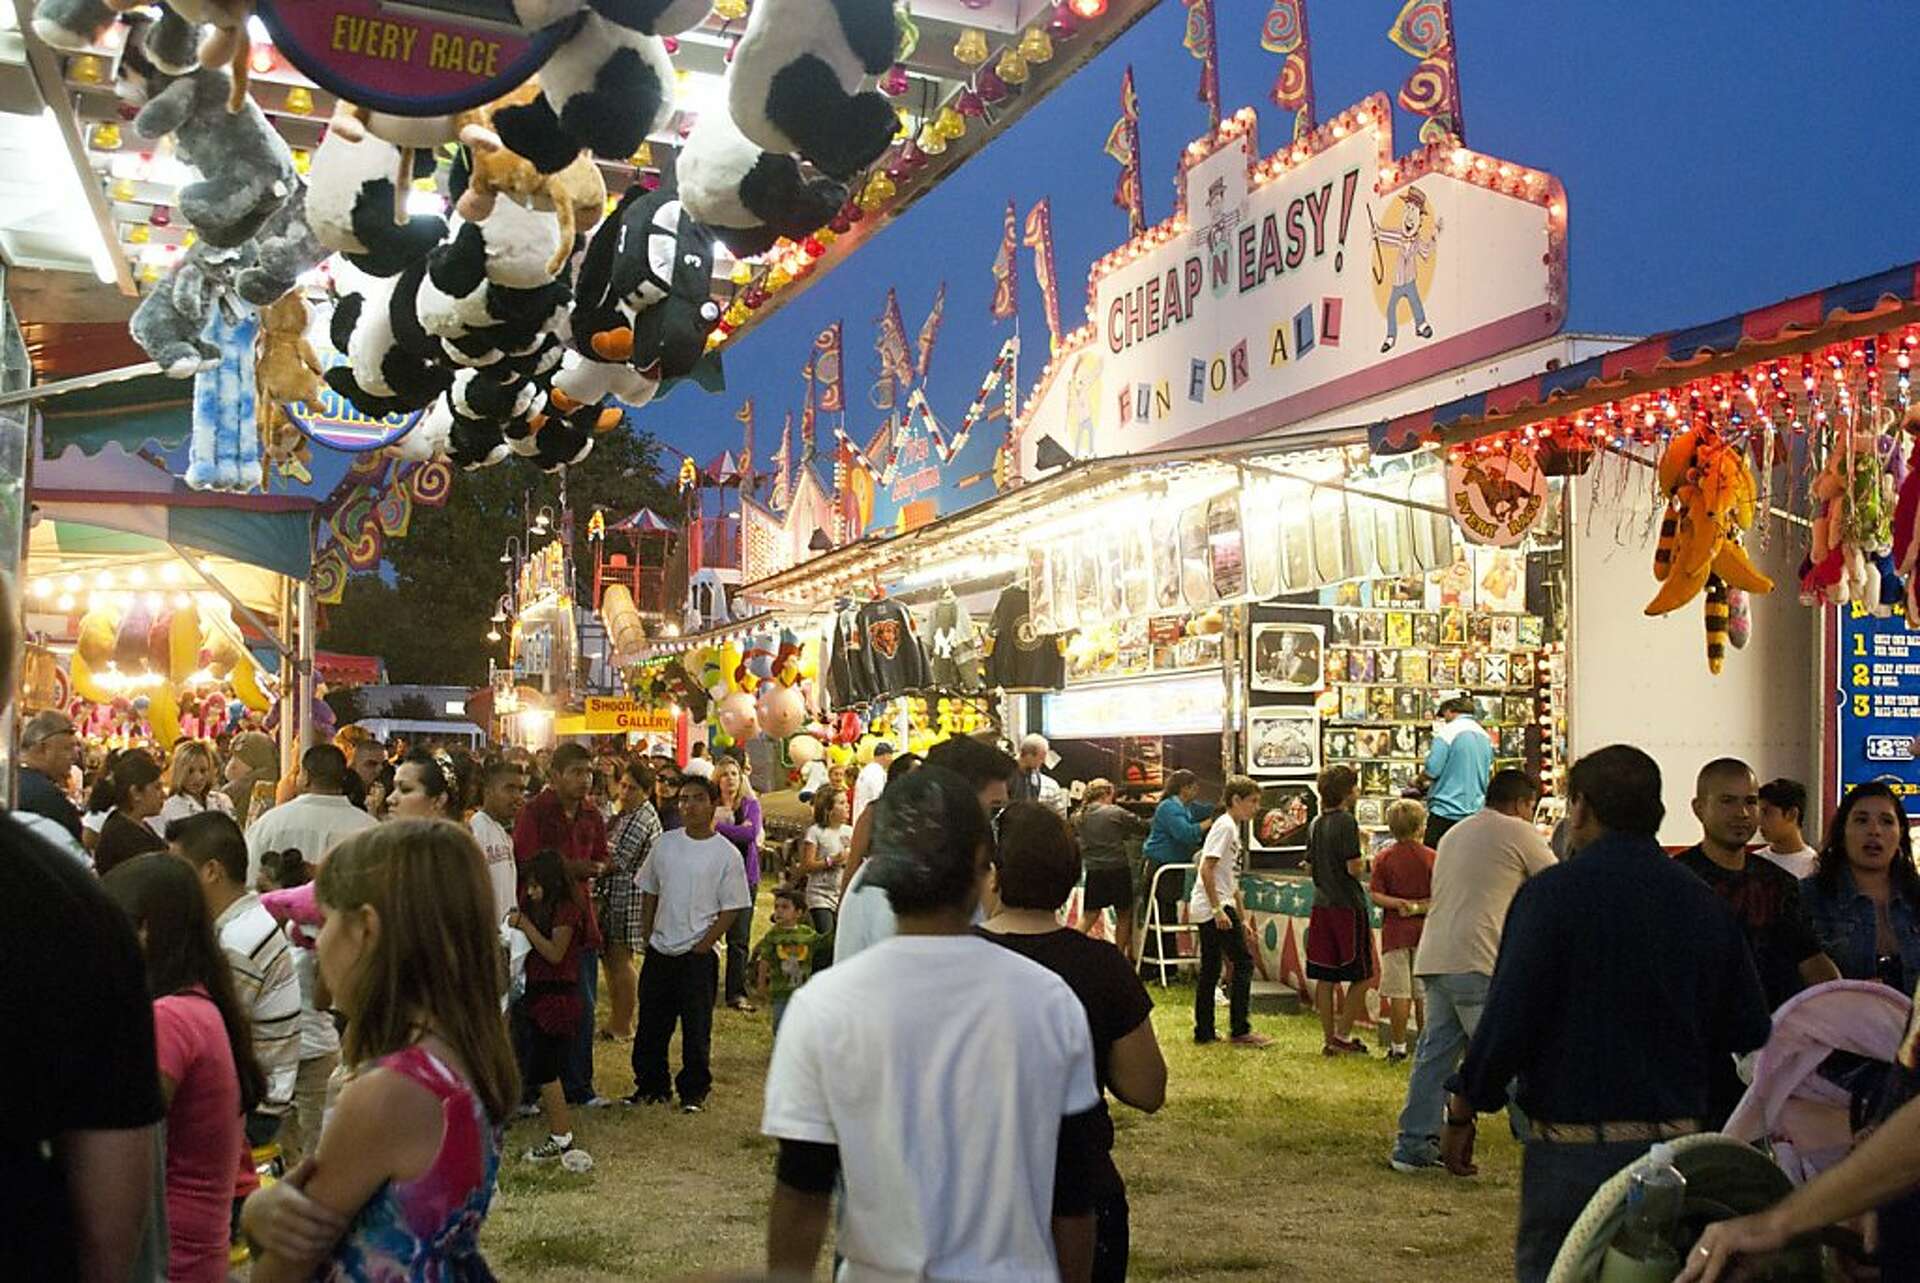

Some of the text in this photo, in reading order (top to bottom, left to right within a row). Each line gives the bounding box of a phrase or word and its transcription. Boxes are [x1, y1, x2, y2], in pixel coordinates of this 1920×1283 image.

[332, 14, 501, 77] EVERY RACE
[1107, 168, 1360, 354] CHEAP N EASY!
[1117, 301, 1339, 424] FUN FOR ALL
[1853, 633, 1868, 656] 1
[1852, 663, 1870, 688] 2
[1853, 694, 1870, 717] 3
[616, 714, 670, 727] GALLERY
